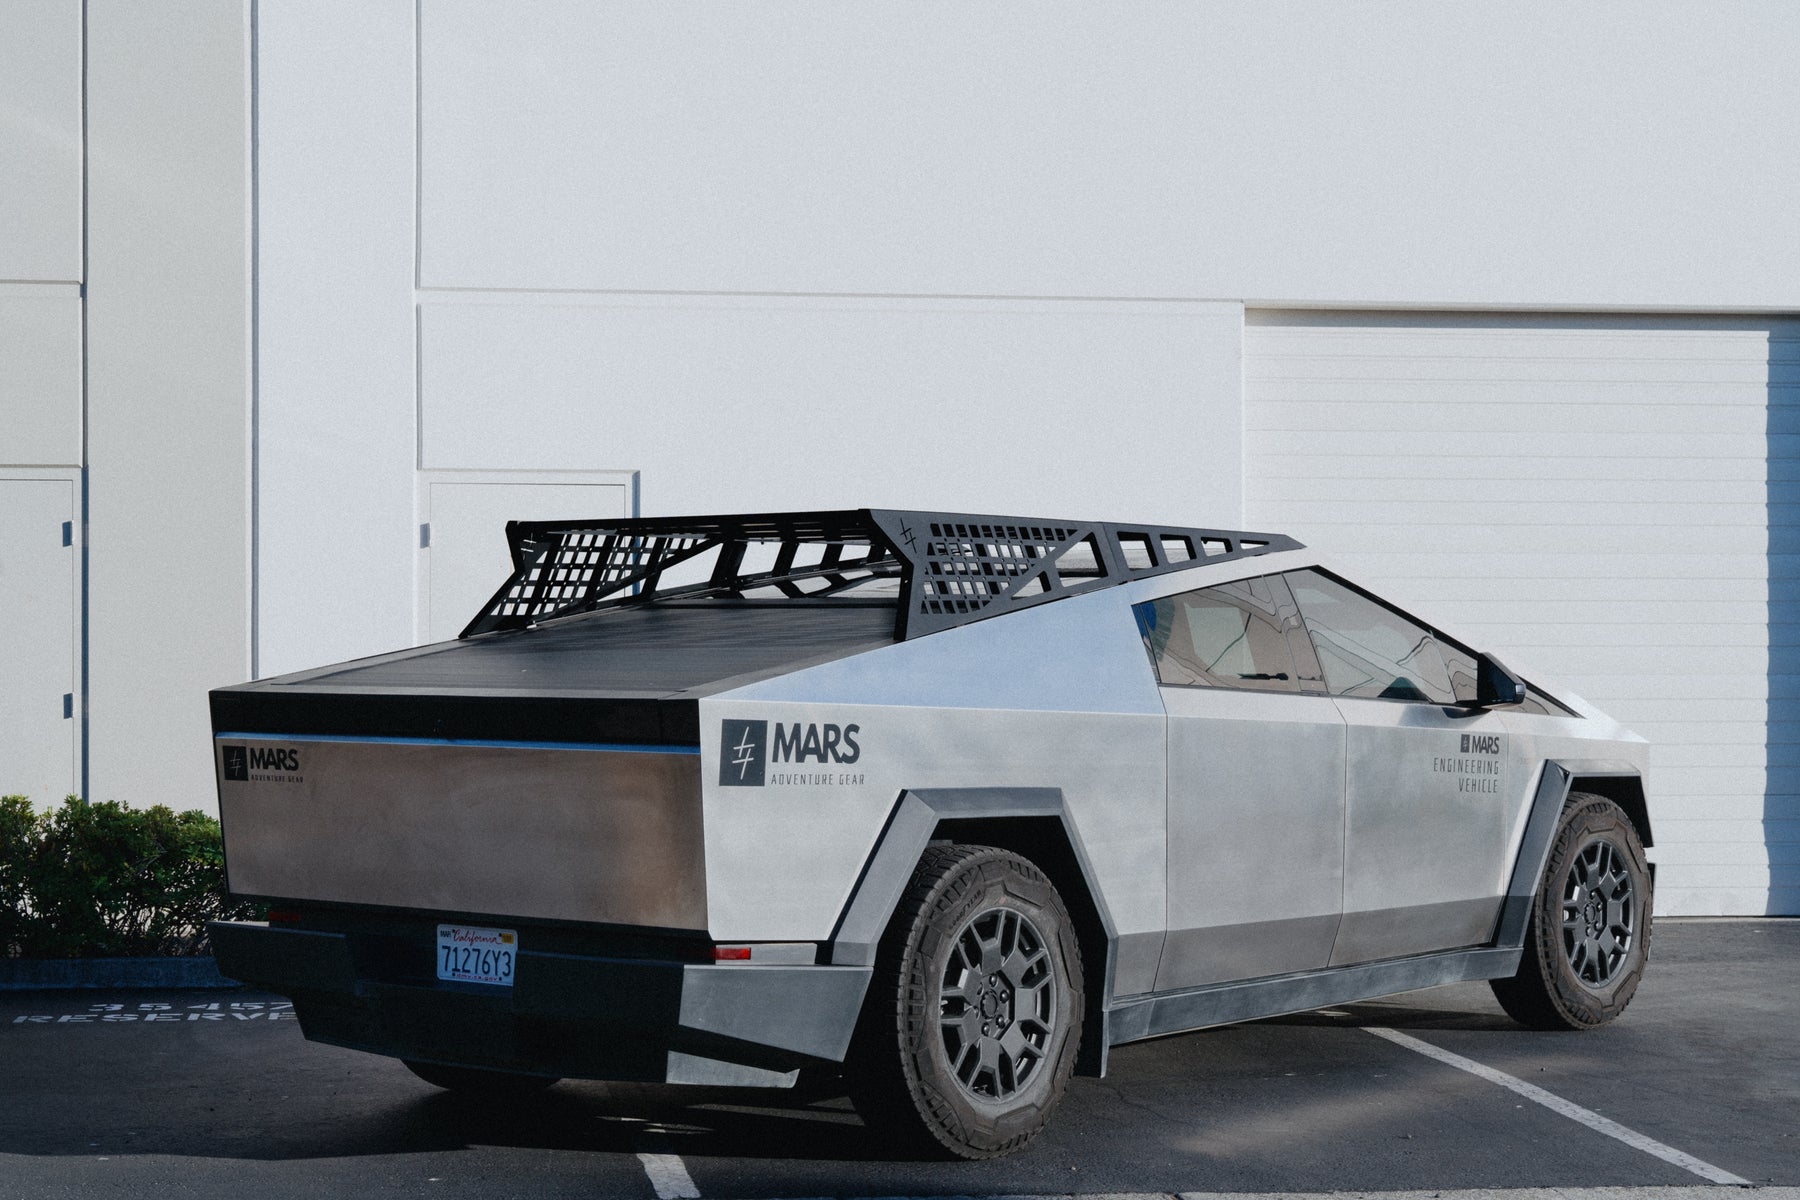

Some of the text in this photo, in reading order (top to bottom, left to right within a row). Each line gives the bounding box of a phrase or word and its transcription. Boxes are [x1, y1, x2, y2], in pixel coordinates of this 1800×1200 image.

[772, 722, 860, 764] MARS
[1472, 735, 1499, 754] MARS
[250, 747, 299, 771] MARS
[1433, 757, 1499, 775] ENGINEERING
[251, 774, 285, 782] ADVENTURE
[771, 773, 865, 785] ADVENTURE GEAR
[1459, 778, 1498, 793] VEHICLE
[453, 929, 502, 946] California
[442, 945, 511, 977] 71276Y3
[12, 1012, 298, 1023] RESERVE
